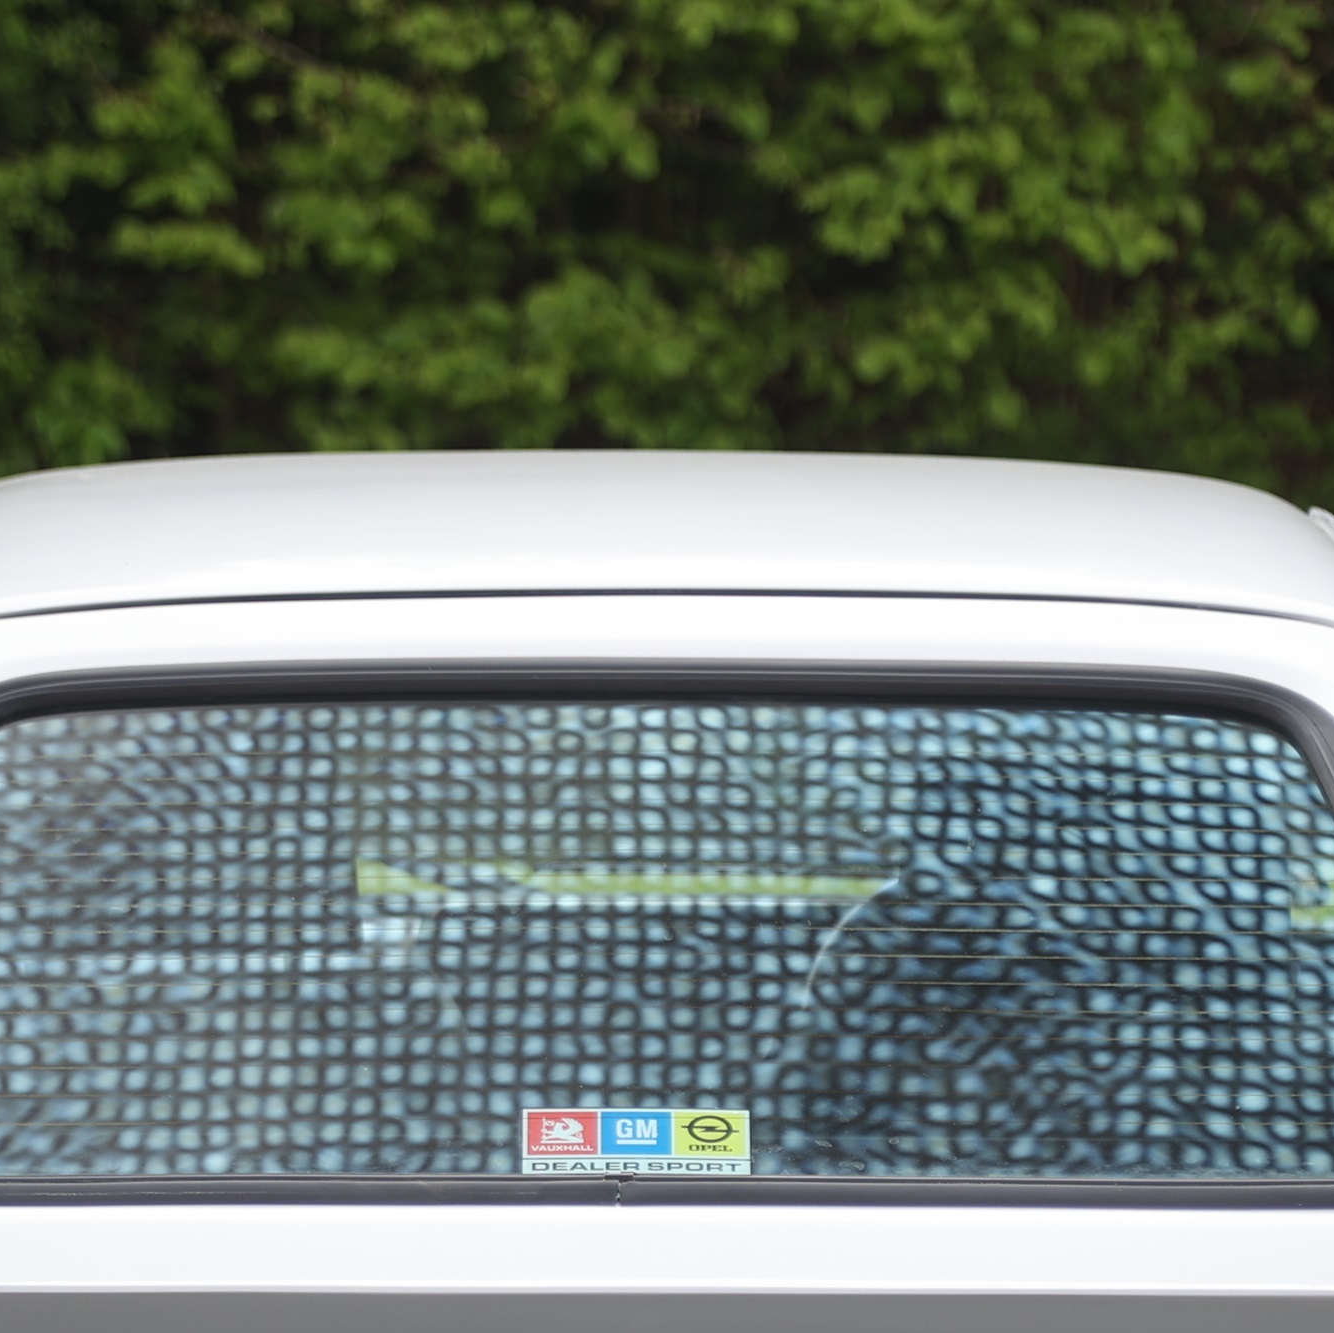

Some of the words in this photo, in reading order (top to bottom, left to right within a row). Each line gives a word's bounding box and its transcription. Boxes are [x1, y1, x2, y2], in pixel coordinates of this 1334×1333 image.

[616, 1118, 658, 1139] GM
[530, 1144, 594, 1152] VAUXHALL
[688, 1144, 733, 1152] OPEL
[531, 1161, 641, 1172] DEALER
[647, 1161, 742, 1173] SPORT
